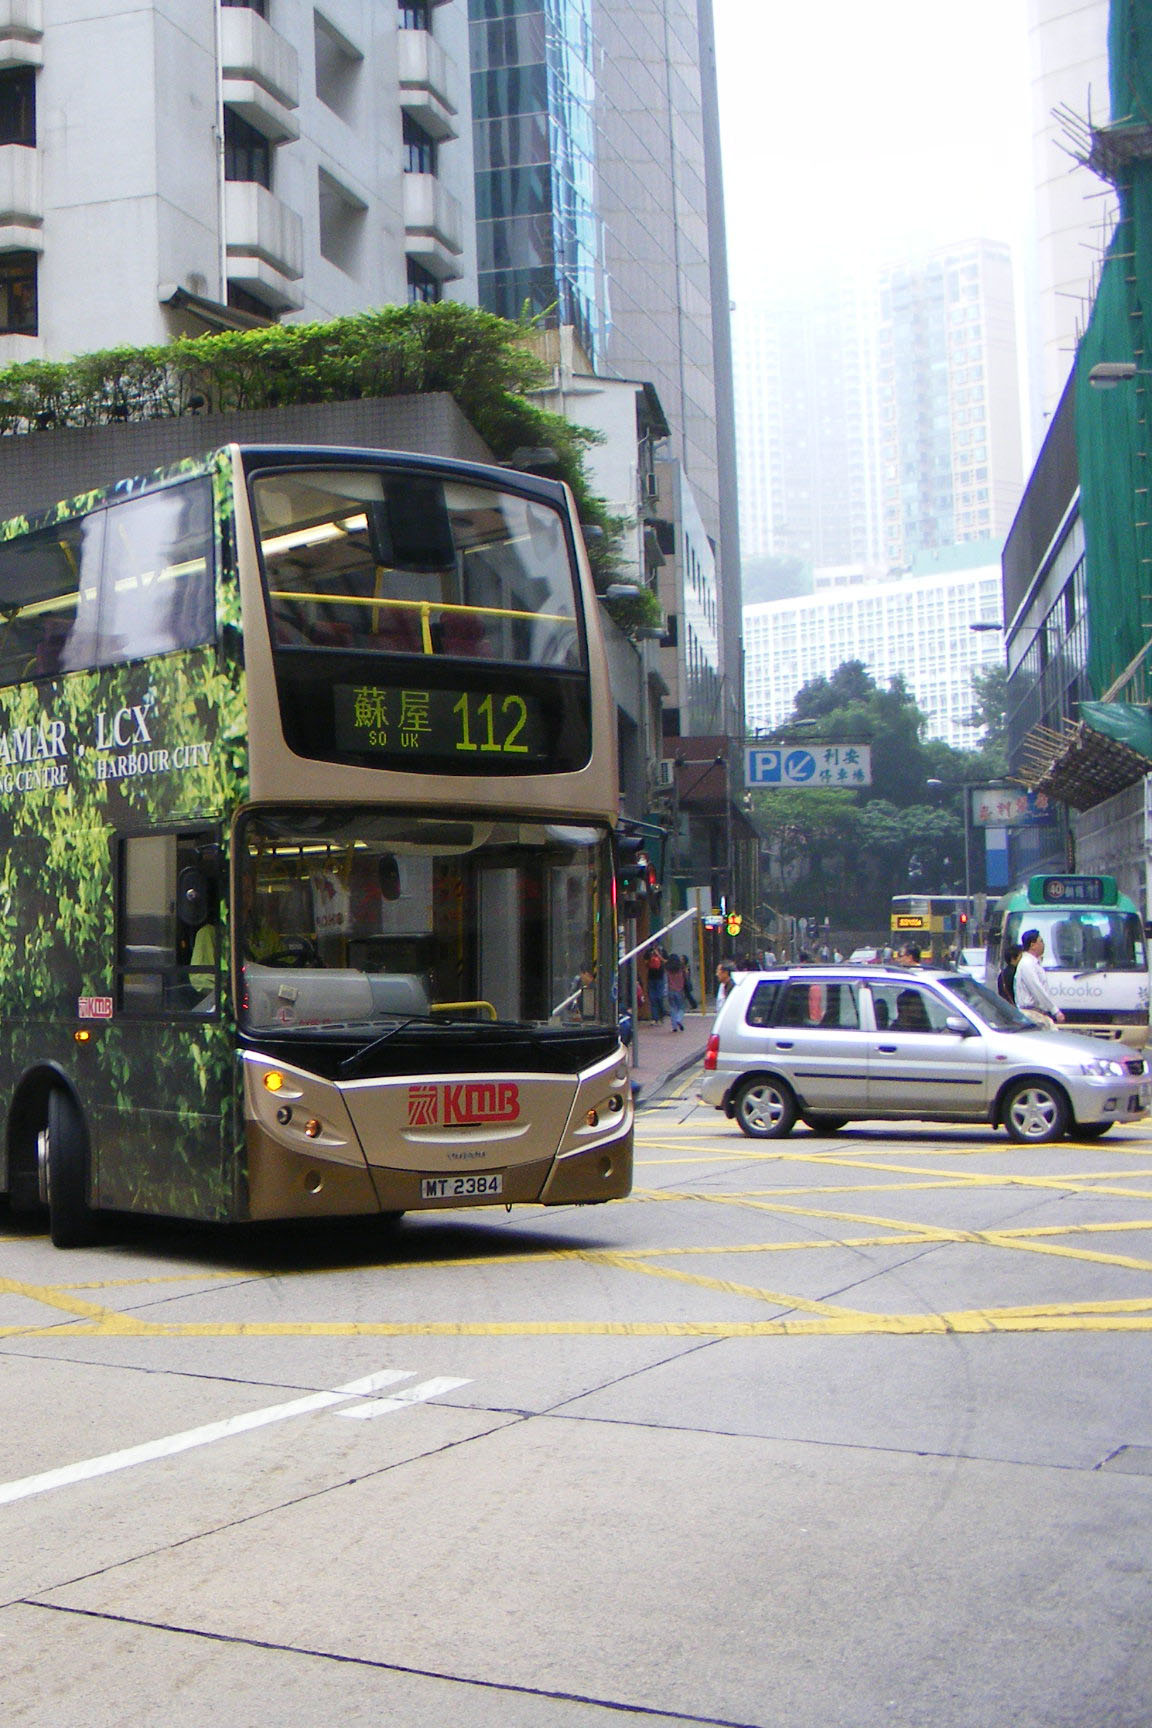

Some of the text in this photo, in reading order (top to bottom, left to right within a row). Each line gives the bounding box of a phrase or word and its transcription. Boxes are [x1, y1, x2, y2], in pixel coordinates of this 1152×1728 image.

[353, 686, 432, 731] 蘇屋
[453, 692, 529, 752] 112
[96, 704, 151, 750] LCX
[369, 730, 419, 748] SO UK
[97, 742, 212, 779] HARBOUR CITY
[755, 752, 777, 781] P
[15, 764, 68, 791] CENTRE
[426, 1176, 498, 1196] MT 2384
